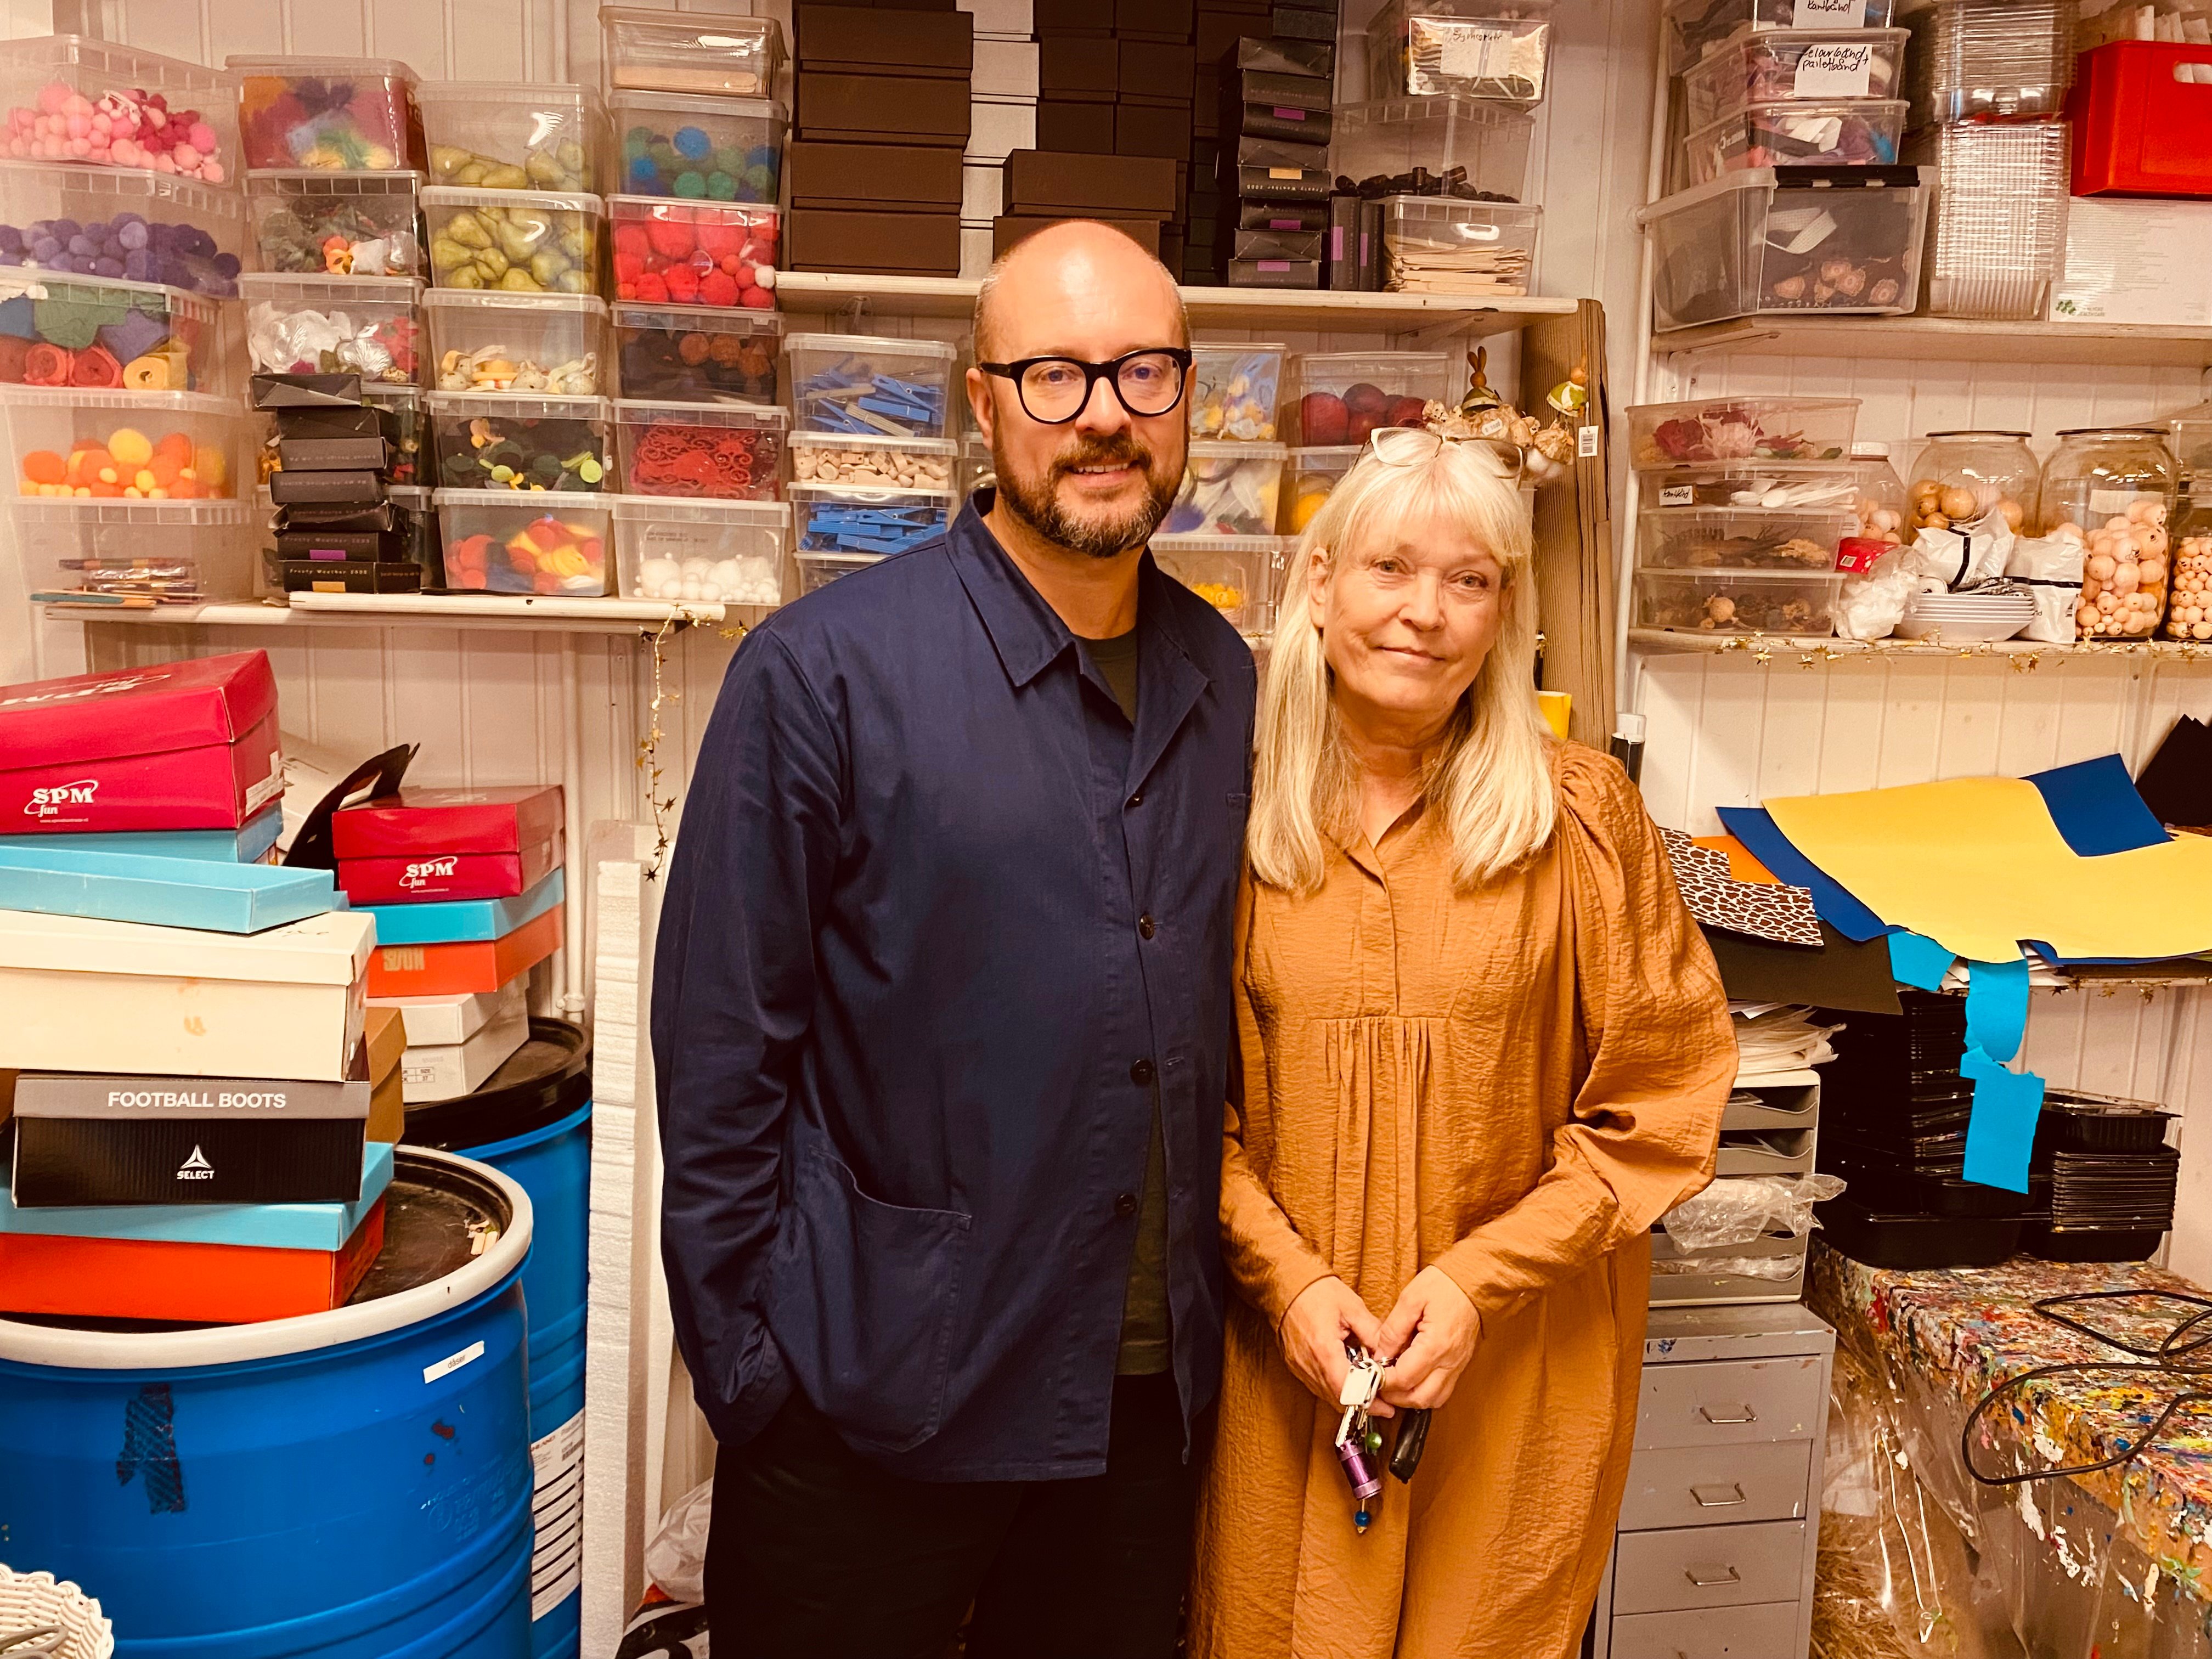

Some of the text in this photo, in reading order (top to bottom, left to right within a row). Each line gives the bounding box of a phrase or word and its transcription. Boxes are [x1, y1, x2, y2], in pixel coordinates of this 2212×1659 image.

[33, 788, 94, 804] SPM
[37, 804, 58, 817] fun
[406, 862, 454, 878] SPM
[409, 877, 426, 889] fun
[108, 1092, 286, 1108] FOOTBALL BOOTS
[177, 1170, 215, 1180] SELECT
